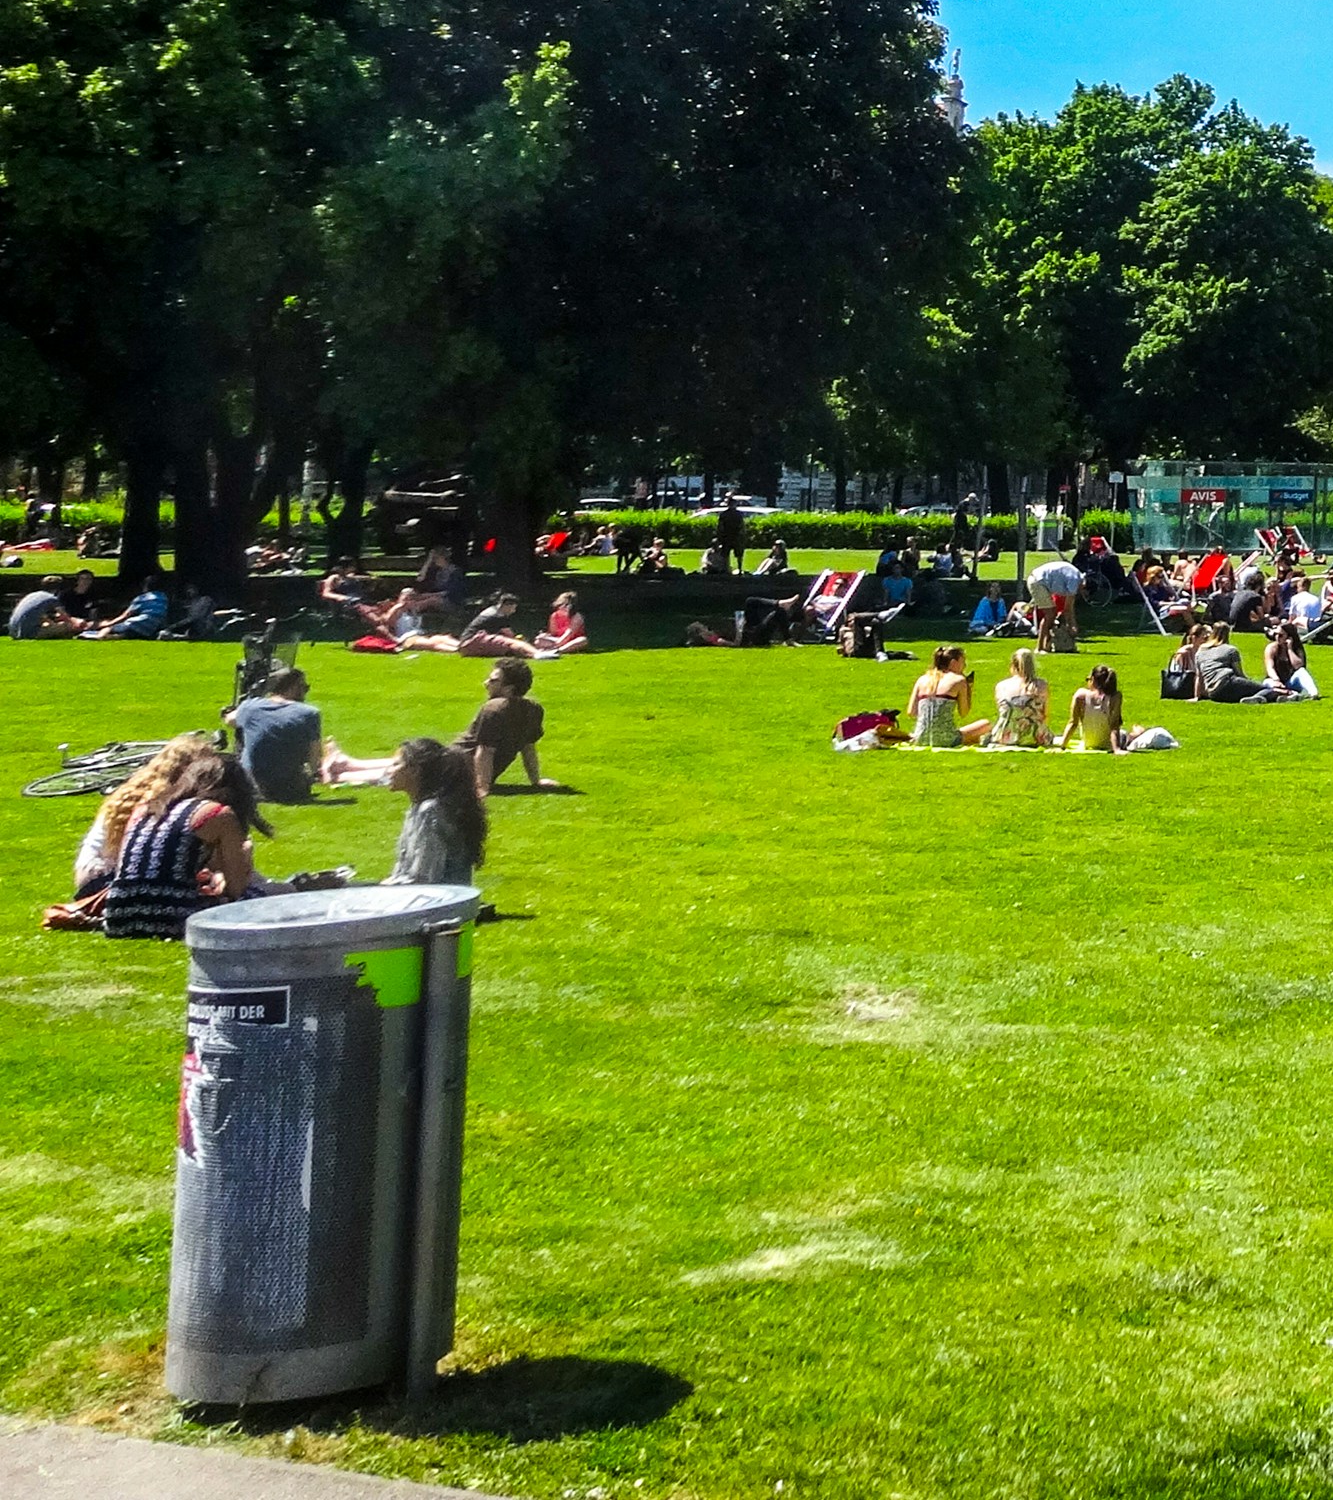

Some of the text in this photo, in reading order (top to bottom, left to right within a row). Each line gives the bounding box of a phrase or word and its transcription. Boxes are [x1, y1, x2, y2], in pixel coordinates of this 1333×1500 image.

[1189, 491, 1217, 501] AVIS
[1283, 491, 1309, 501] Budget
[240, 1004, 266, 1020] DER
